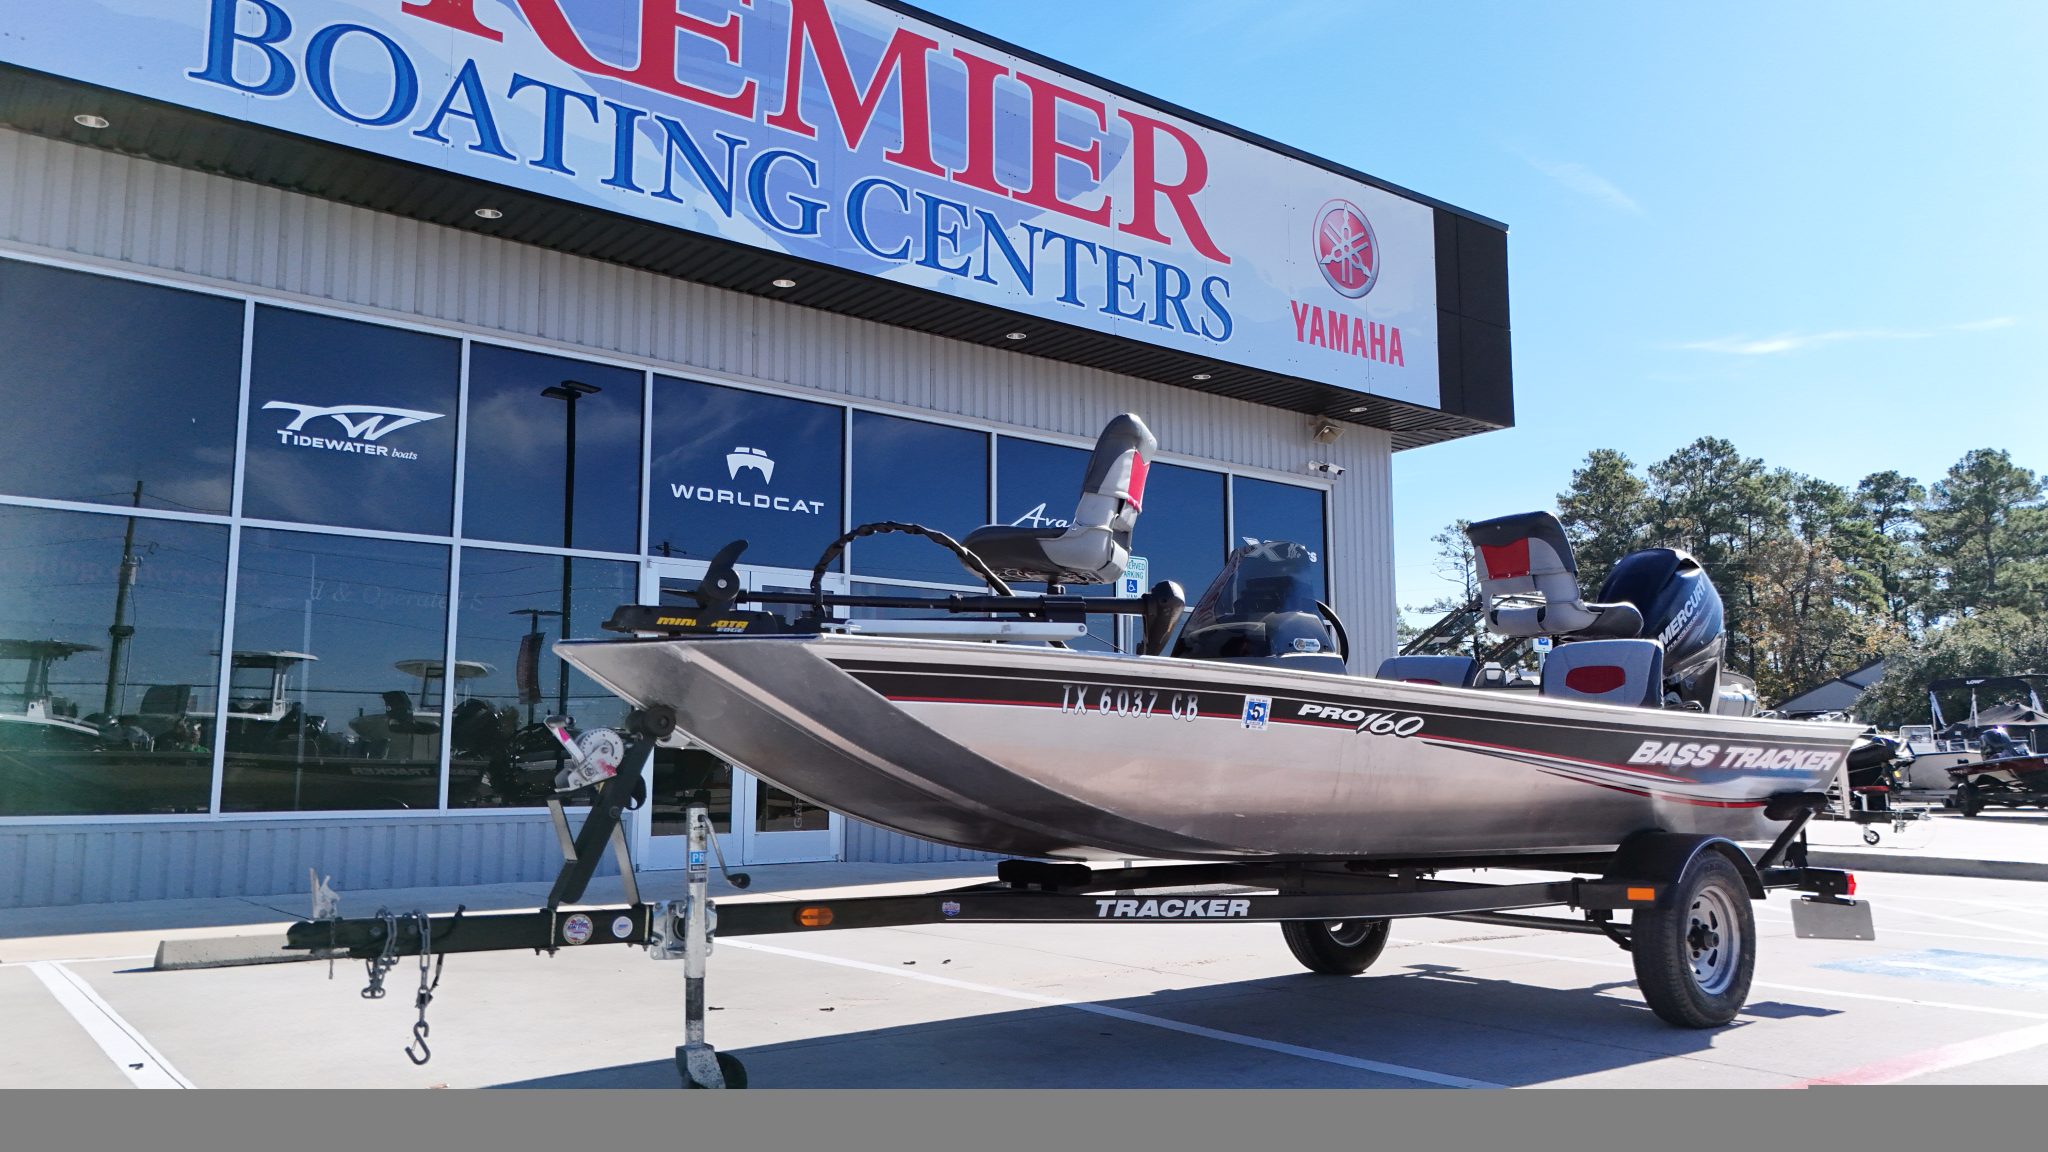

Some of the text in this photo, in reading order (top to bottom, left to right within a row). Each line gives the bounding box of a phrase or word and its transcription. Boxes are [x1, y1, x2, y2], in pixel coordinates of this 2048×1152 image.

[189, 0, 1234, 343] BOATING CENTERS
[1291, 299, 1405, 368] YAMAHA
[277, 429, 418, 461] TIDEWATER boats
[671, 483, 825, 515] WORLDCAT
[1010, 502, 1077, 529] Ava
[1123, 570, 1144, 579] ARKING
[1658, 576, 1706, 645] MERCURY
[1062, 684, 1199, 722] TX 6037 CB
[1628, 740, 1842, 771] BASS TRACKER
[1095, 899, 1251, 918] TRACKER
